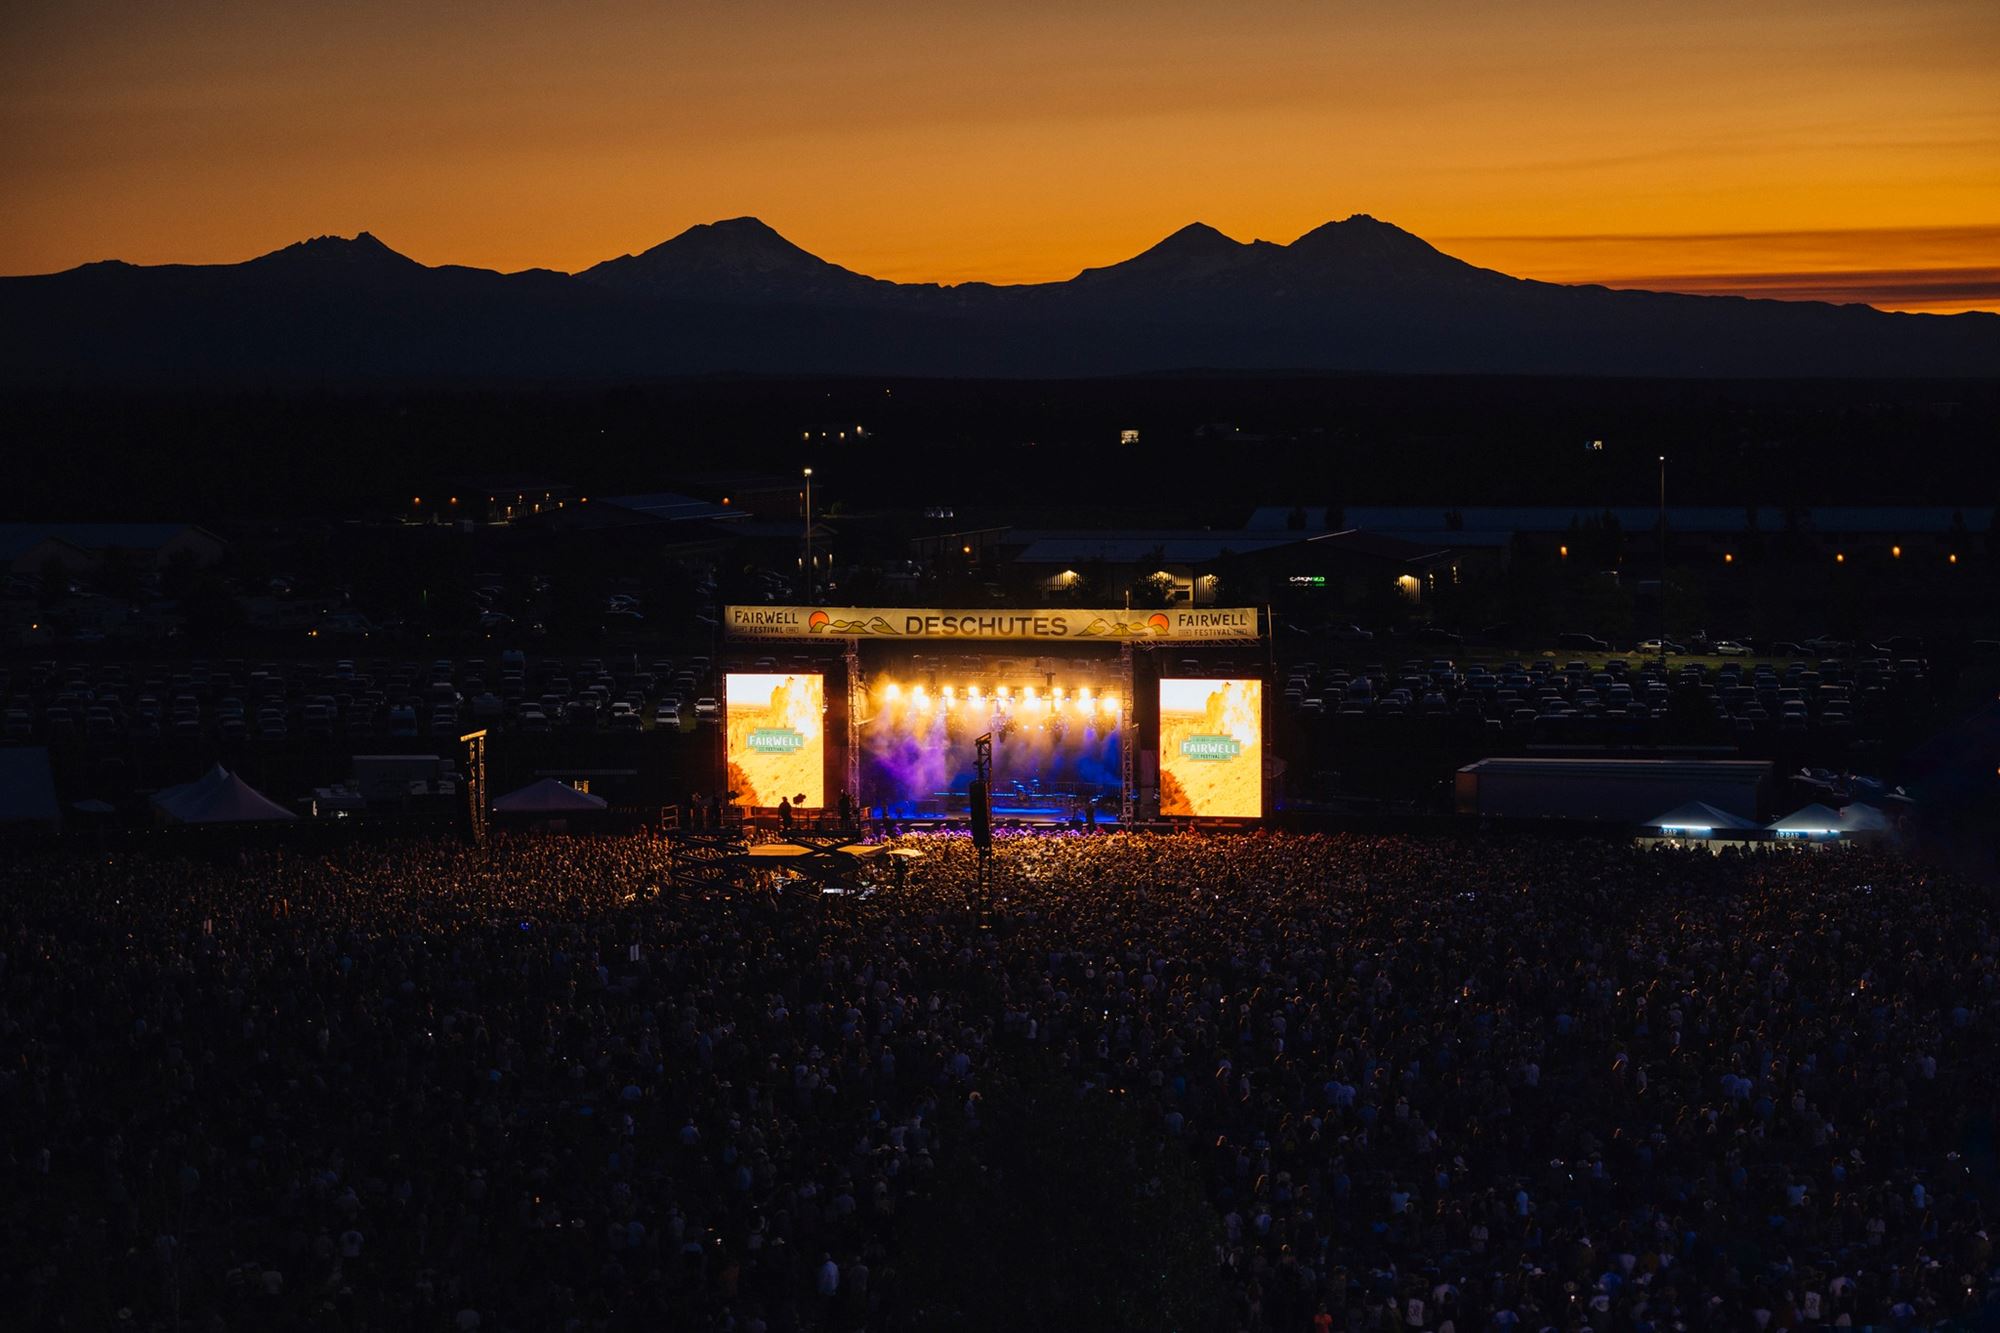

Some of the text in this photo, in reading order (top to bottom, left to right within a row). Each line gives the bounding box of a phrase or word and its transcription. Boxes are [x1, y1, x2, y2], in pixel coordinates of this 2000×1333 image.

[734, 610, 799, 624] FAIRWELL
[1178, 613, 1247, 627] FAIRWELL
[749, 626, 784, 634] FESTIVAL
[905, 616, 1068, 636] DESCHUTES
[1194, 629, 1232, 637] FESTIVAL
[749, 735, 802, 747] FAIRWELL
[1183, 743, 1238, 754] FAIRWELL
